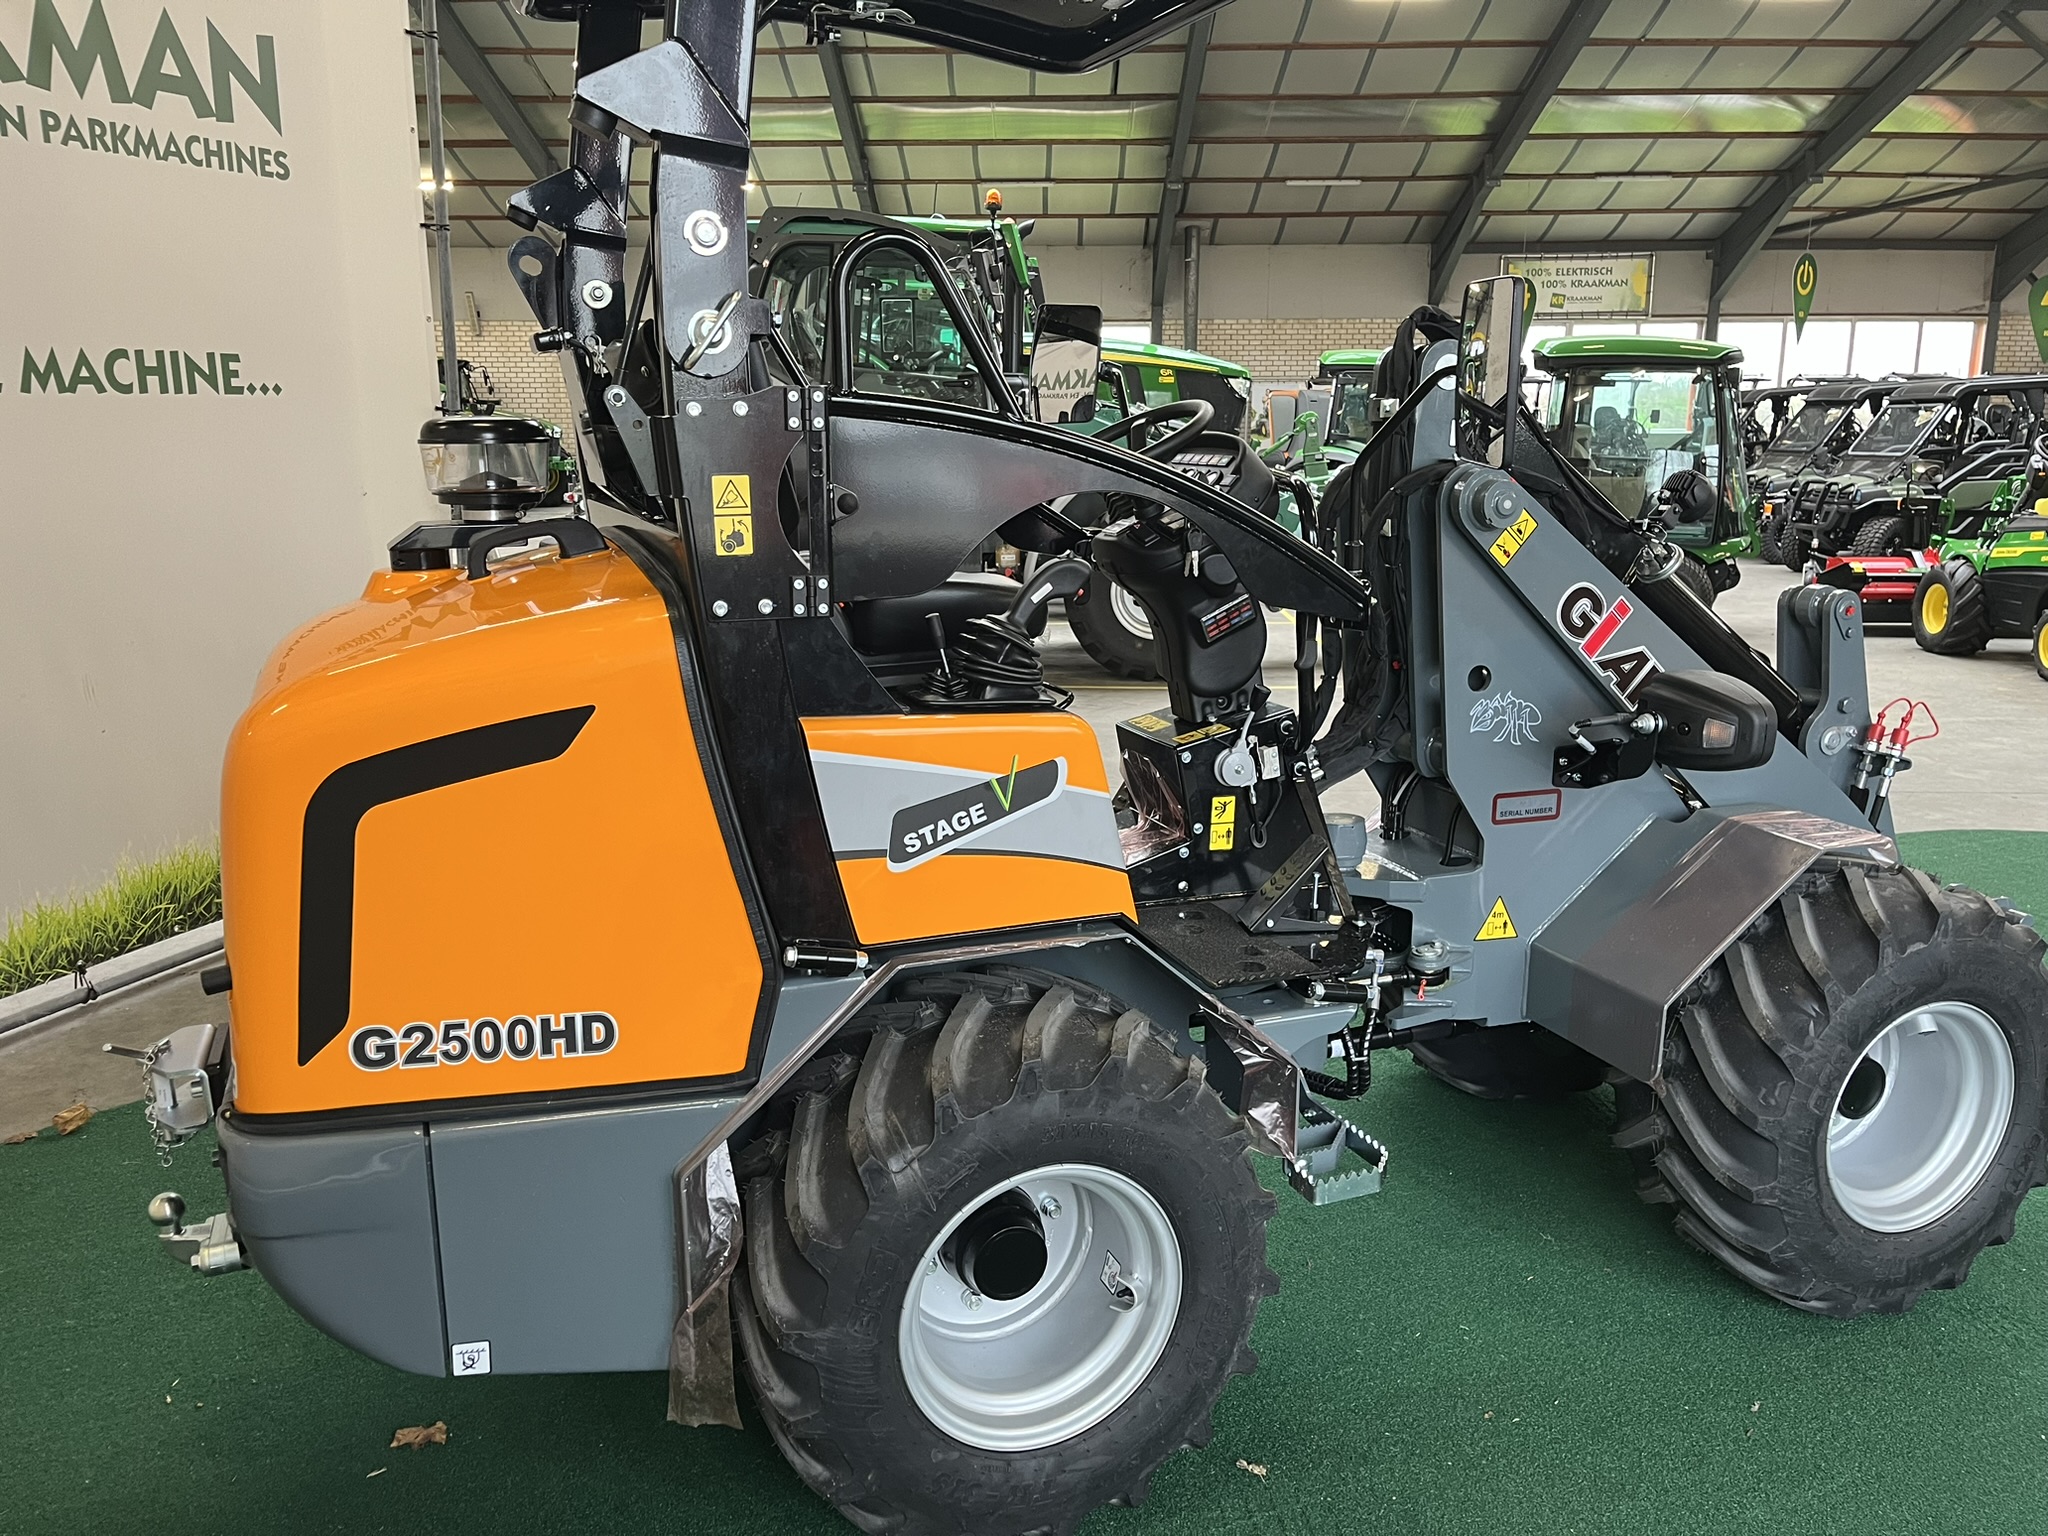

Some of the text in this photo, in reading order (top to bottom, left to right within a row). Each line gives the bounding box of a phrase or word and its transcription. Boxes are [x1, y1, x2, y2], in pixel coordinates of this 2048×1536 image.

[0, 0, 283, 137] MAN
[40, 109, 291, 181] PARKMACHINES
[1525, 266, 1613, 277] 100% ELEKTRISCH
[1541, 278, 1629, 289] 100% KRAAKMAN
[1551, 294, 1566, 305] KR
[20, 346, 283, 397] MACHINE...
[903, 802, 988, 853] STAGE
[1499, 806, 1554, 818] SERIAL NUMBER
[1491, 911, 1505, 919] 4m
[350, 1011, 619, 1073] G2500HD
